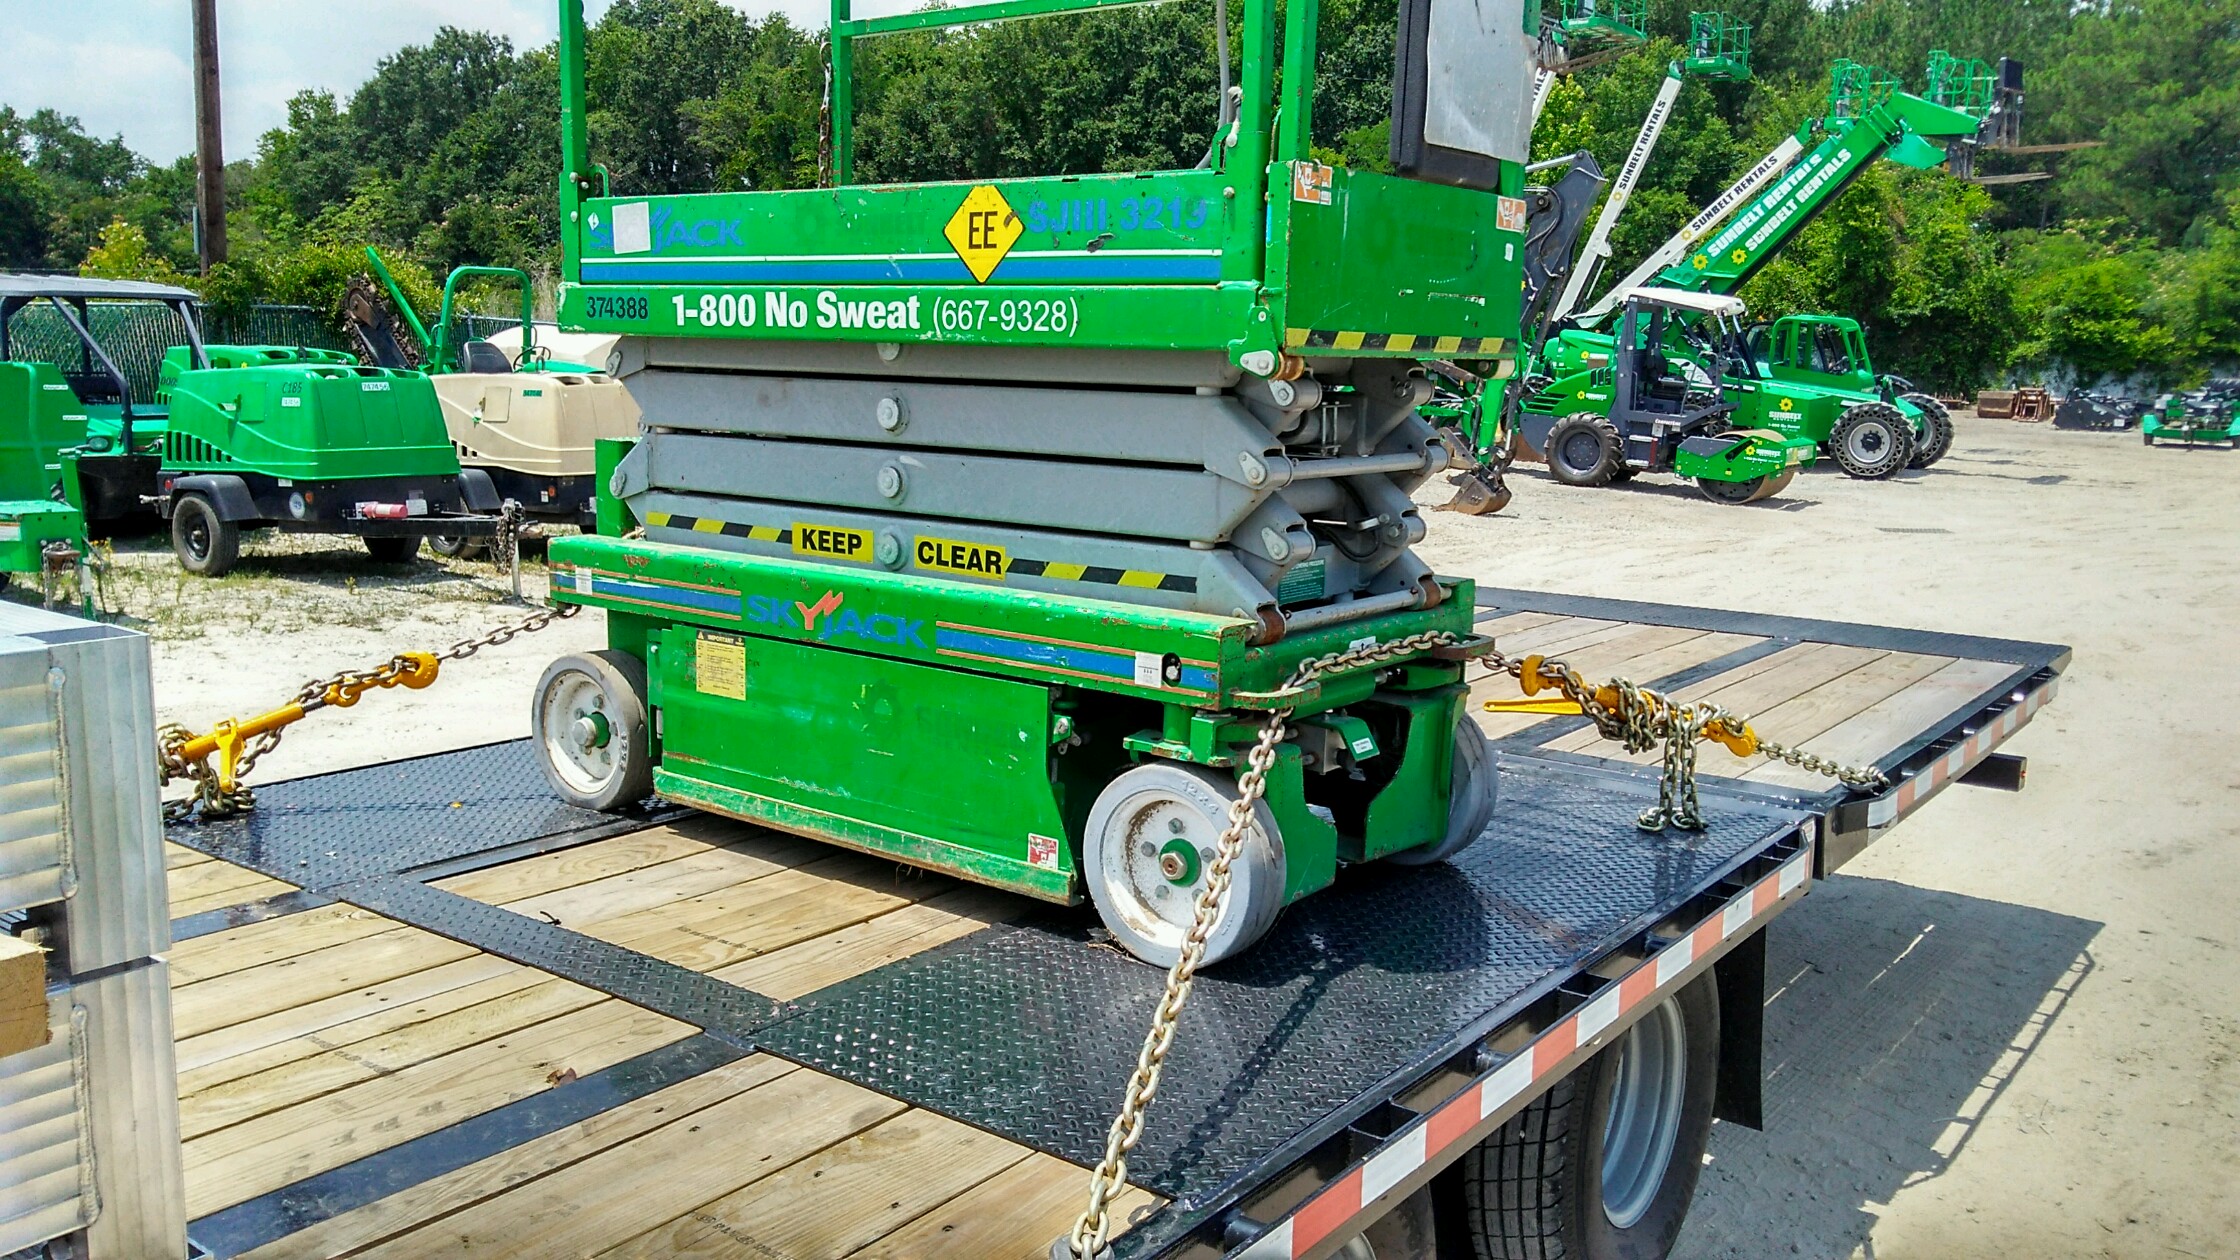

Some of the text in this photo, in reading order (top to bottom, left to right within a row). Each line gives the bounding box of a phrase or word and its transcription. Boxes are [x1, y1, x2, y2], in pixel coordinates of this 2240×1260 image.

[1618, 100, 1667, 190] SUNBELT RENTALS
[1028, 196, 1208, 234] SJIII 3219
[1692, 155, 1778, 232] SUNBELT RENTALS
[1744, 148, 1853, 251] SUNBELT RENTALS
[967, 210, 998, 250] EE
[1707, 204, 1766, 257] SUNBELT
[586, 296, 649, 319] 374388
[671, 290, 1079, 338] 1-800 No Sweat (667-9328)
[802, 528, 1002, 575] KEEP CLEAR
[747, 589, 928, 650] SKYJACK
